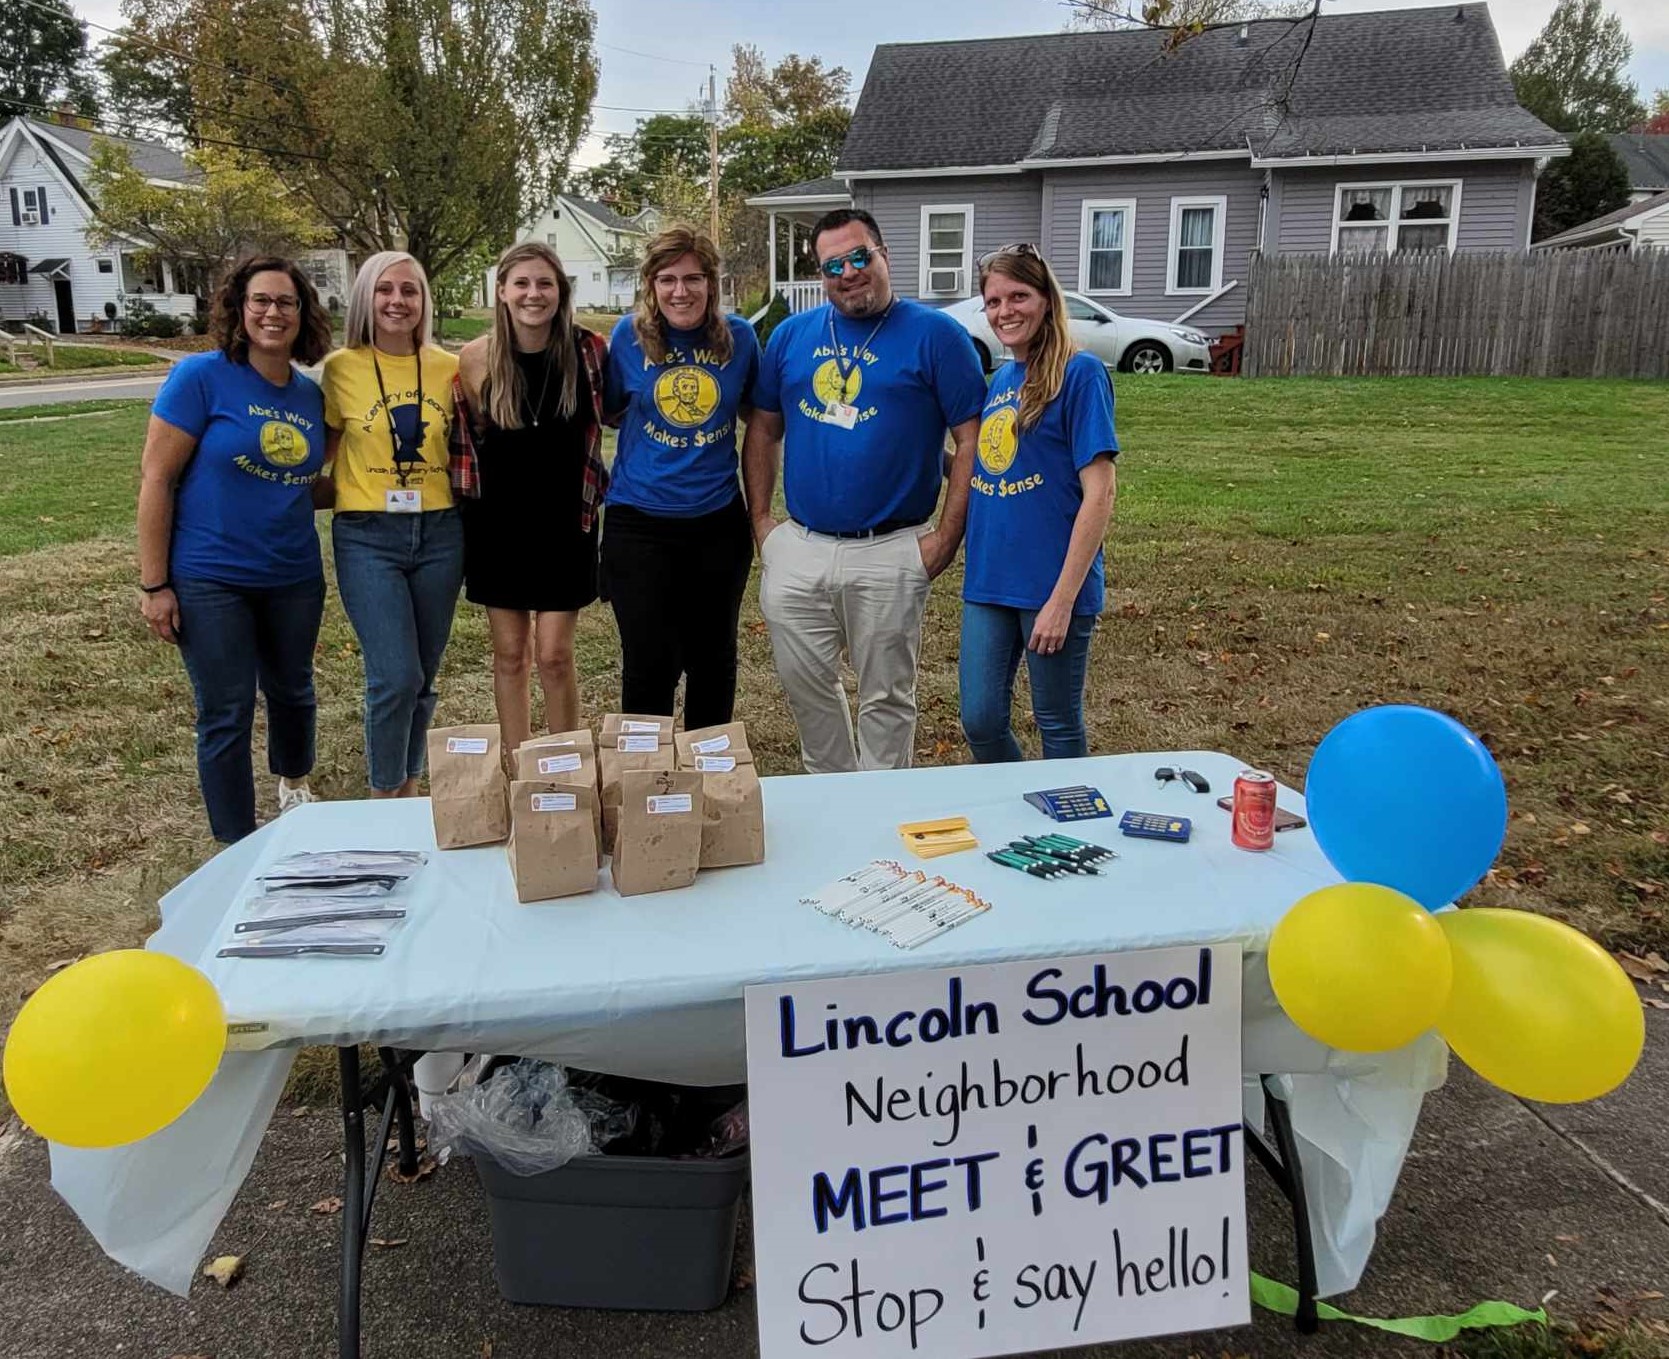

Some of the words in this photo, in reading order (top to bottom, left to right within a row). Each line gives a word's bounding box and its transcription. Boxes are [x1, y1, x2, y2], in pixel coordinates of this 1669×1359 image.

[643, 347, 686, 371] Ae's
[248, 403, 280, 419] Abe's
[284, 410, 314, 431] Way
[798, 398, 826, 423] Make
[643, 420, 688, 448] Makes
[233, 454, 279, 481] Makes
[970, 474, 995, 496] akes
[998, 472, 1045, 498] $ense
[779, 976, 999, 1058] Lincoln
[1022, 947, 1212, 1026] School
[845, 1034, 1190, 1146] Neighborhood
[812, 1151, 1000, 1233] MEET
[1064, 1123, 1243, 1205] GREET
[798, 1258, 944, 1349] Stop
[1013, 1260, 1097, 1331] say
[1112, 1216, 1230, 1298] hello!
